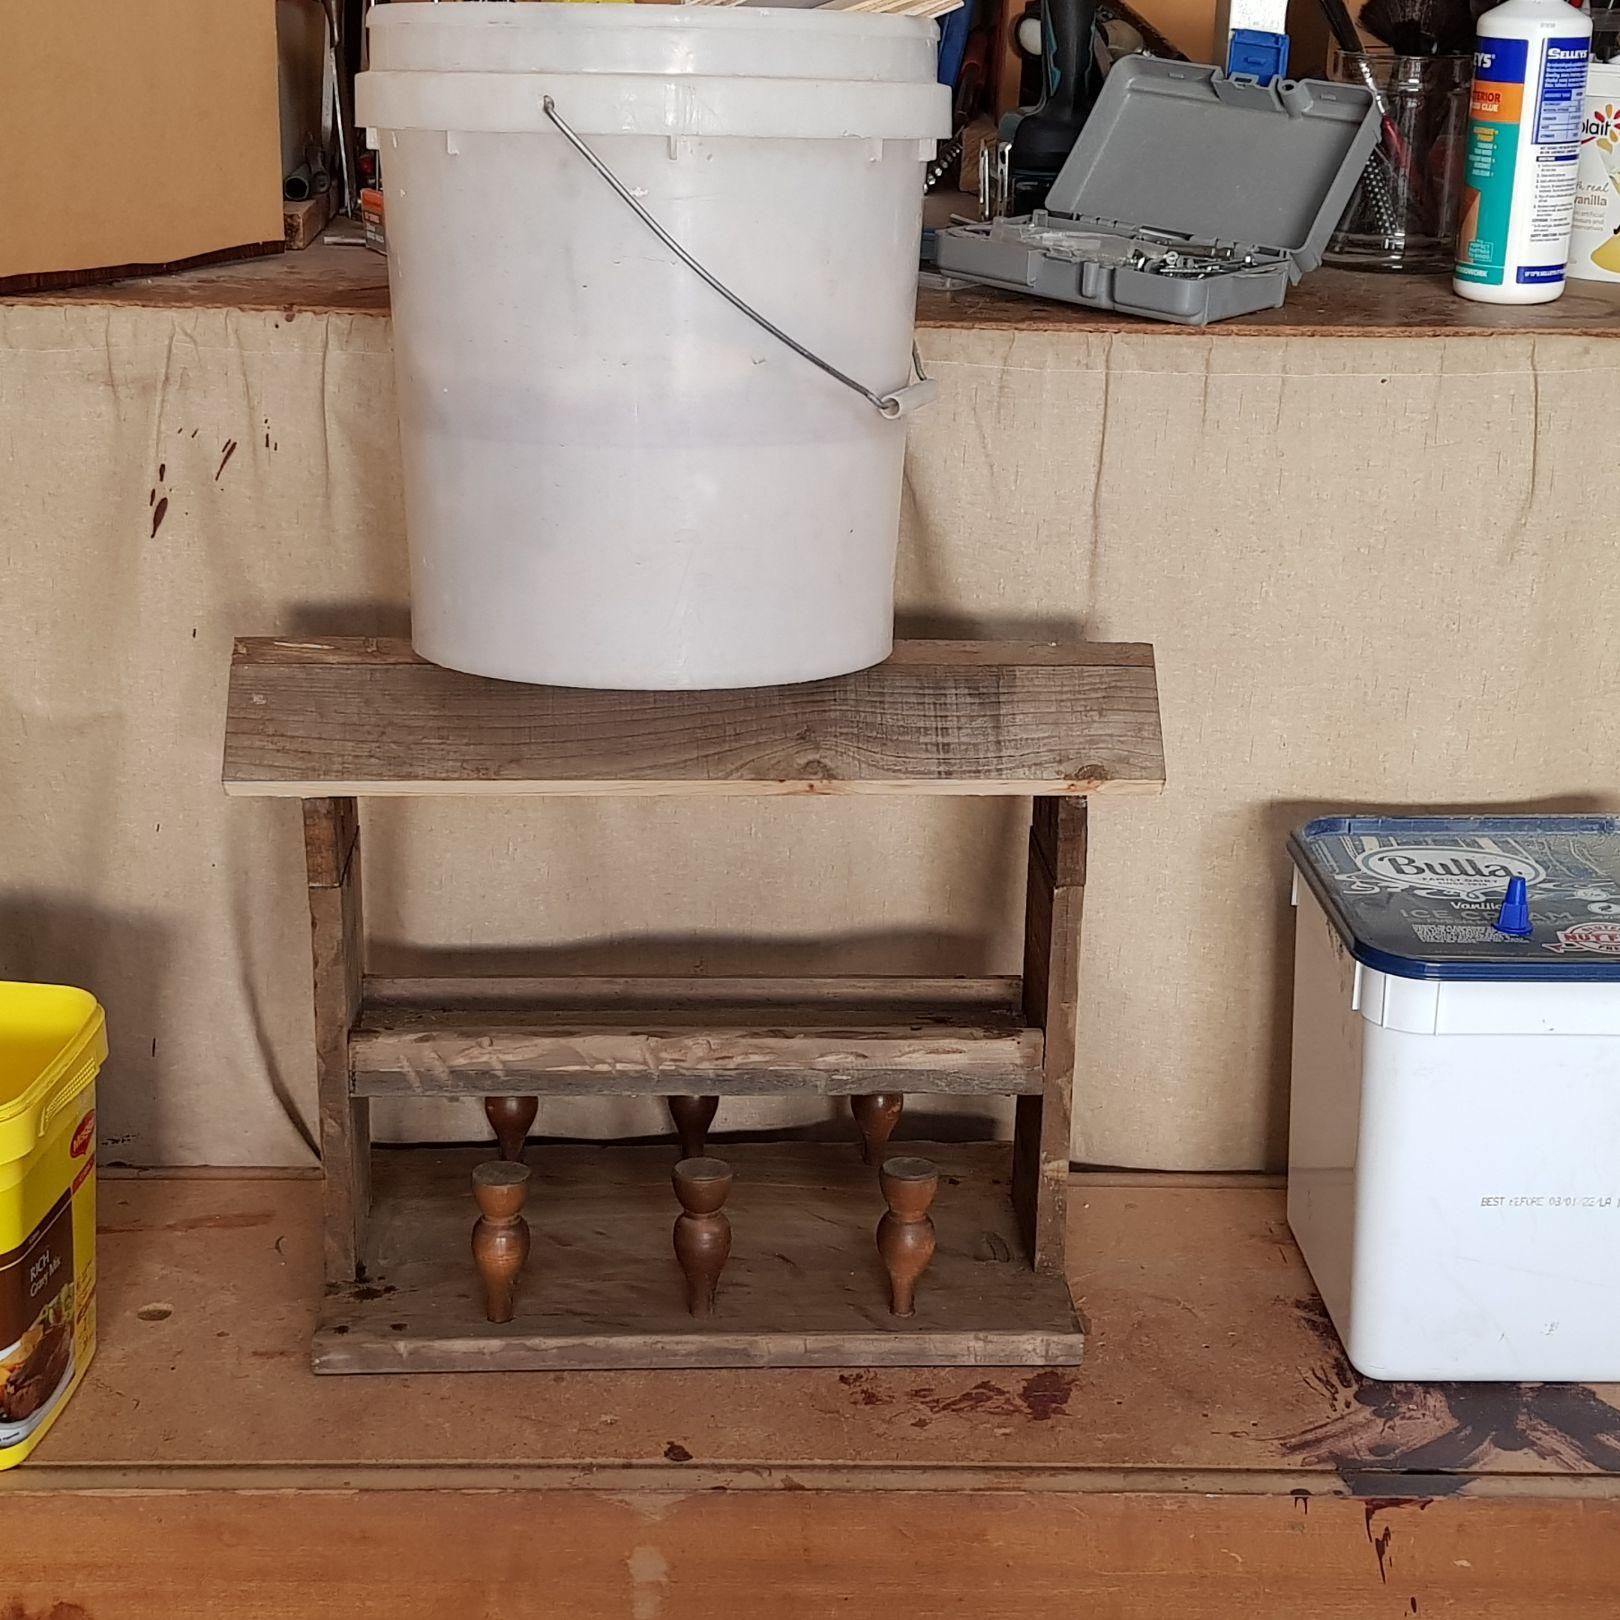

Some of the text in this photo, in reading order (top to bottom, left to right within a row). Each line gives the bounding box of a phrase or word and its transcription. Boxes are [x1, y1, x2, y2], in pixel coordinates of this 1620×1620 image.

[1378, 855, 1514, 878] Bulla
[1400, 909, 1575, 921] ICE CRAM
[1480, 1196, 1505, 1207] BEST
[30, 1249, 50, 1282] RICH
